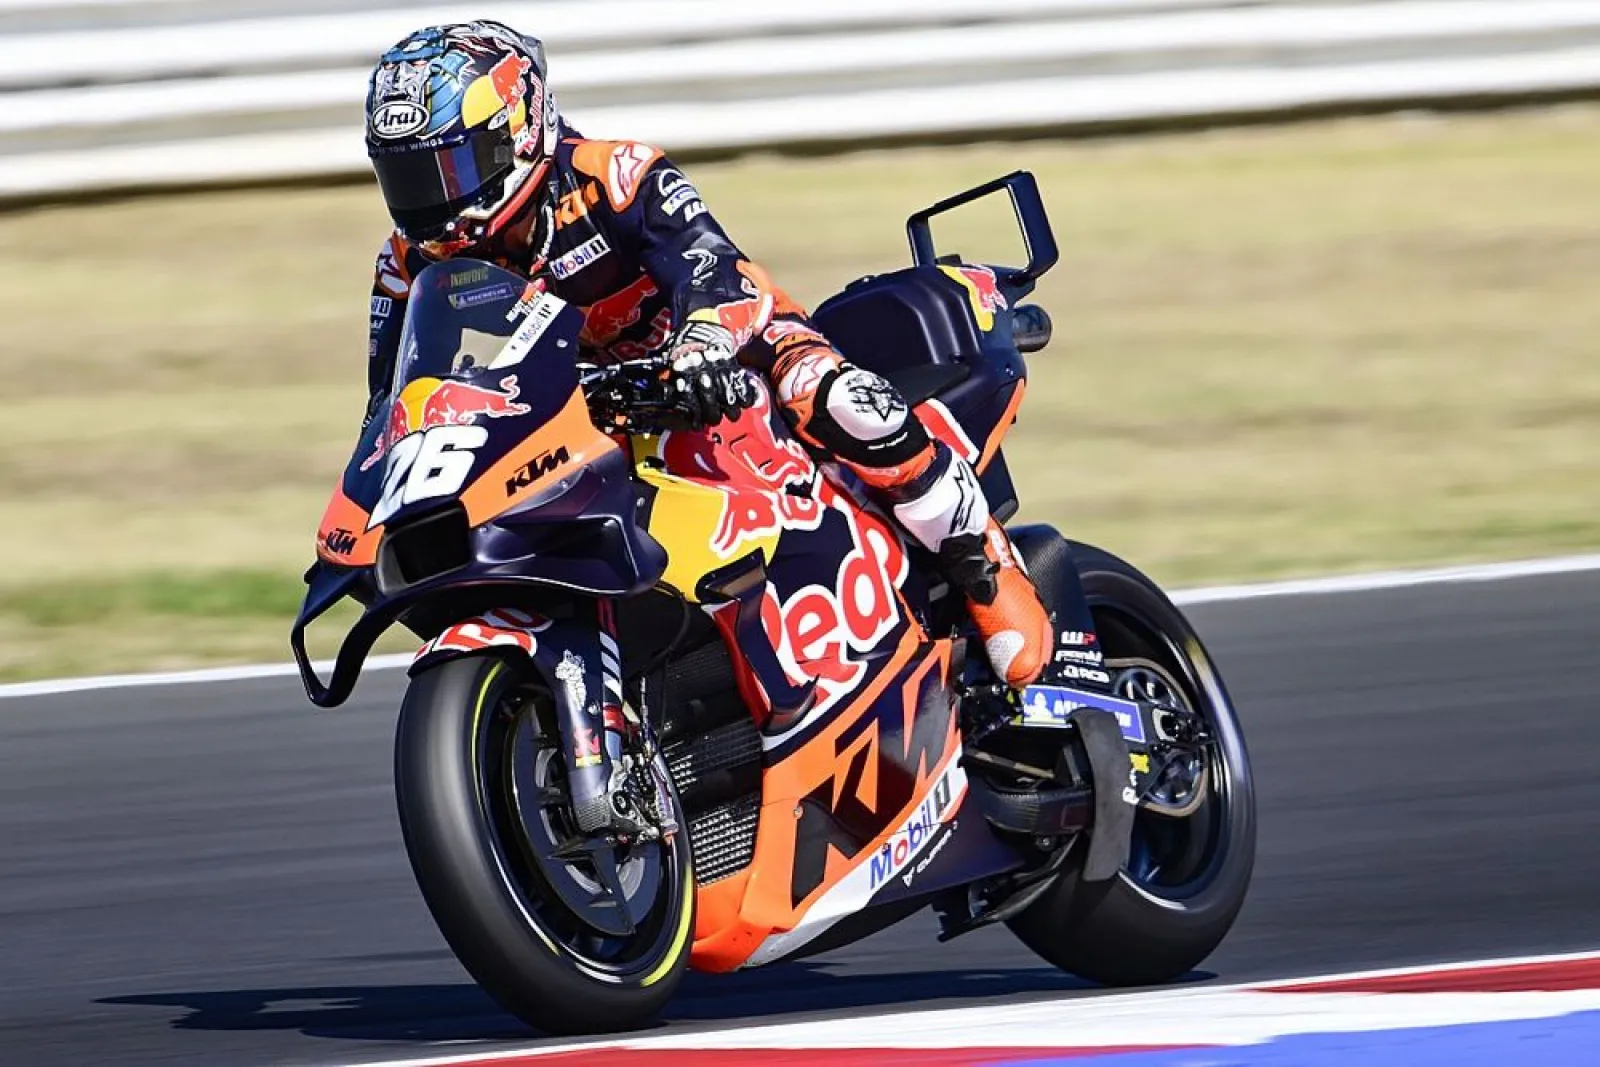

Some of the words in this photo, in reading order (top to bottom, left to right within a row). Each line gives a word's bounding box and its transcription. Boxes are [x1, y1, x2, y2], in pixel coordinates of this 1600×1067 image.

[374, 107, 417, 128] Arai
[552, 243, 594, 278] Mobil
[367, 424, 489, 530] 26
[505, 445, 571, 498] KTM
[325, 527, 358, 556] KTM
[868, 796, 932, 891] Mobil
